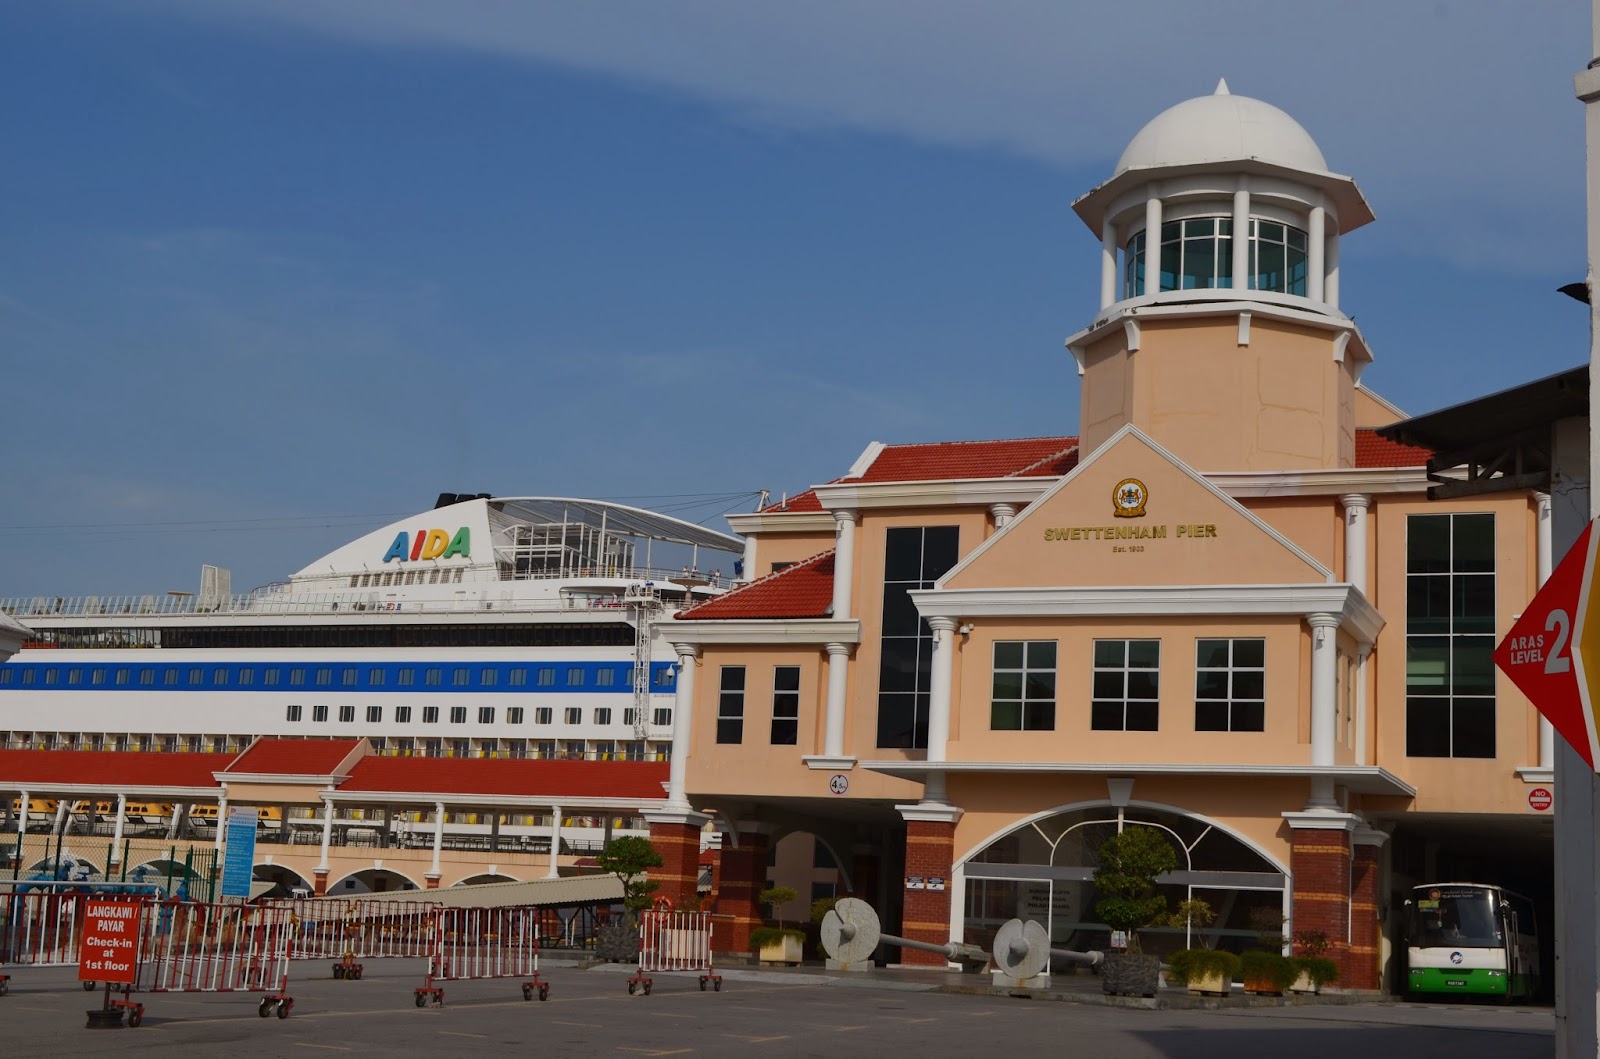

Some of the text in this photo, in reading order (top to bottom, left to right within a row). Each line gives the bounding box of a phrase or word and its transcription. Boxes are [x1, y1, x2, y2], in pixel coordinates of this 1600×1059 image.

[1044, 524, 1217, 541] SWETTENHAM PIER
[382, 526, 471, 563] AIDA
[1510, 634, 1544, 650] ARAS
[1544, 608, 1570, 674] 2
[1510, 649, 1544, 665] LEVEL
[87, 905, 132, 919] LANGKAWI
[97, 919, 125, 933] PAYAR
[86, 936, 133, 948] Check-in
[103, 949, 114, 957] at
[85, 959, 130, 971] 1st floor
